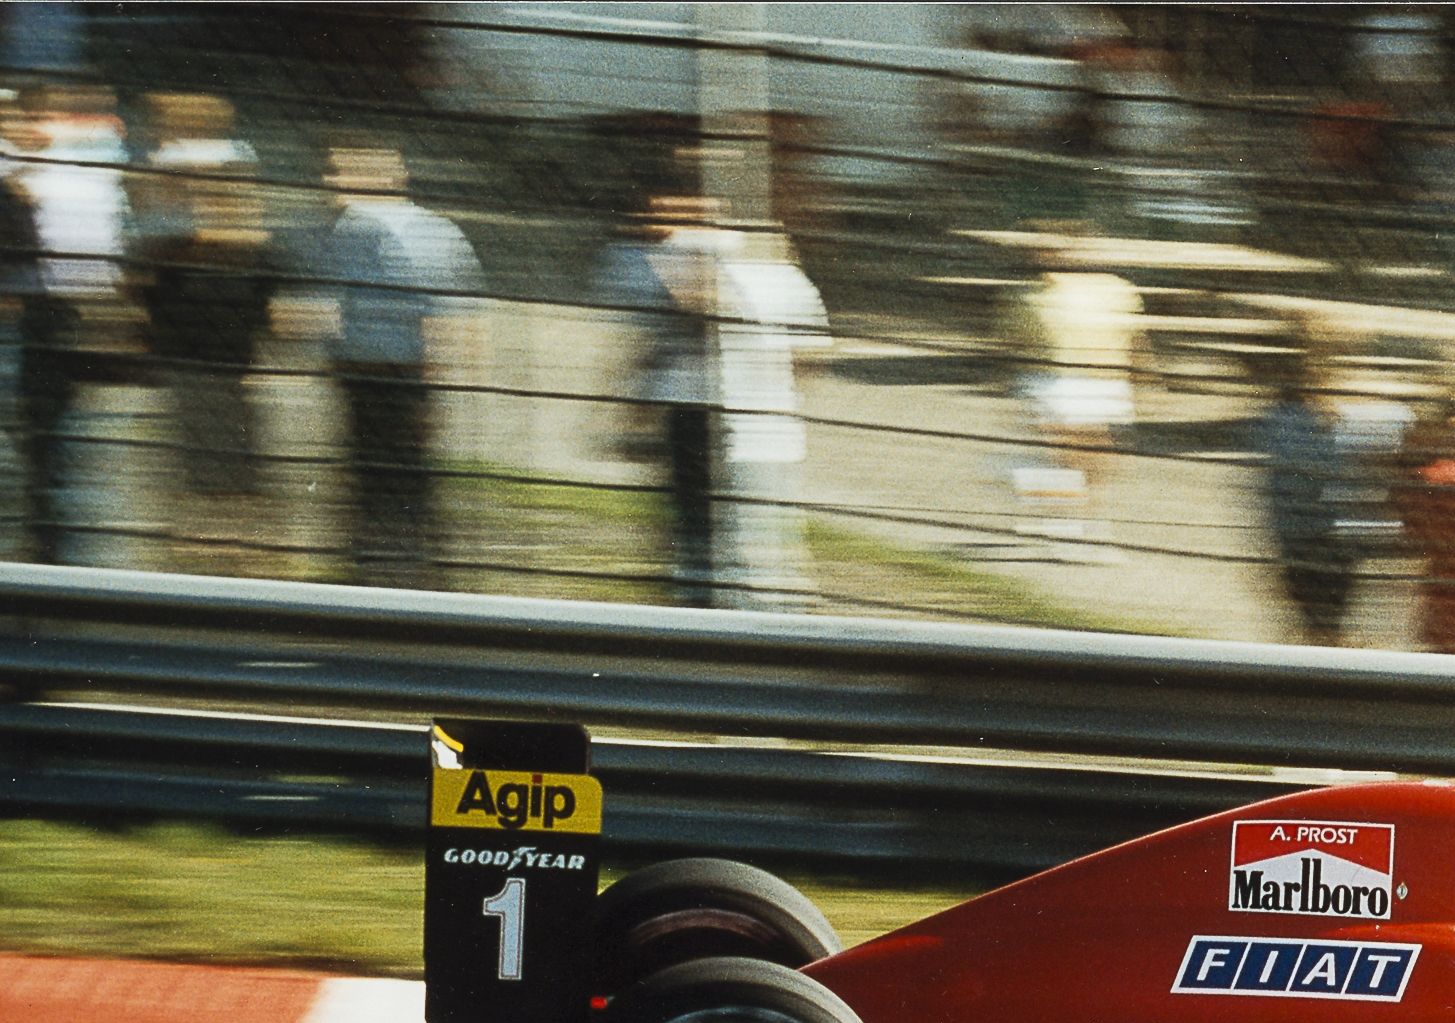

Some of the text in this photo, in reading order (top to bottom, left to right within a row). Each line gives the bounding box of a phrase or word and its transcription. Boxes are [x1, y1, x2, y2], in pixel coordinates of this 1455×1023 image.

[456, 769, 577, 830] Agip
[443, 846, 587, 871] GOODYEAR
[1269, 825, 1359, 845] A. PROST
[1231, 857, 1389, 917] Marlboro
[482, 877, 527, 982] 1
[1196, 947, 1402, 990] FIAT
